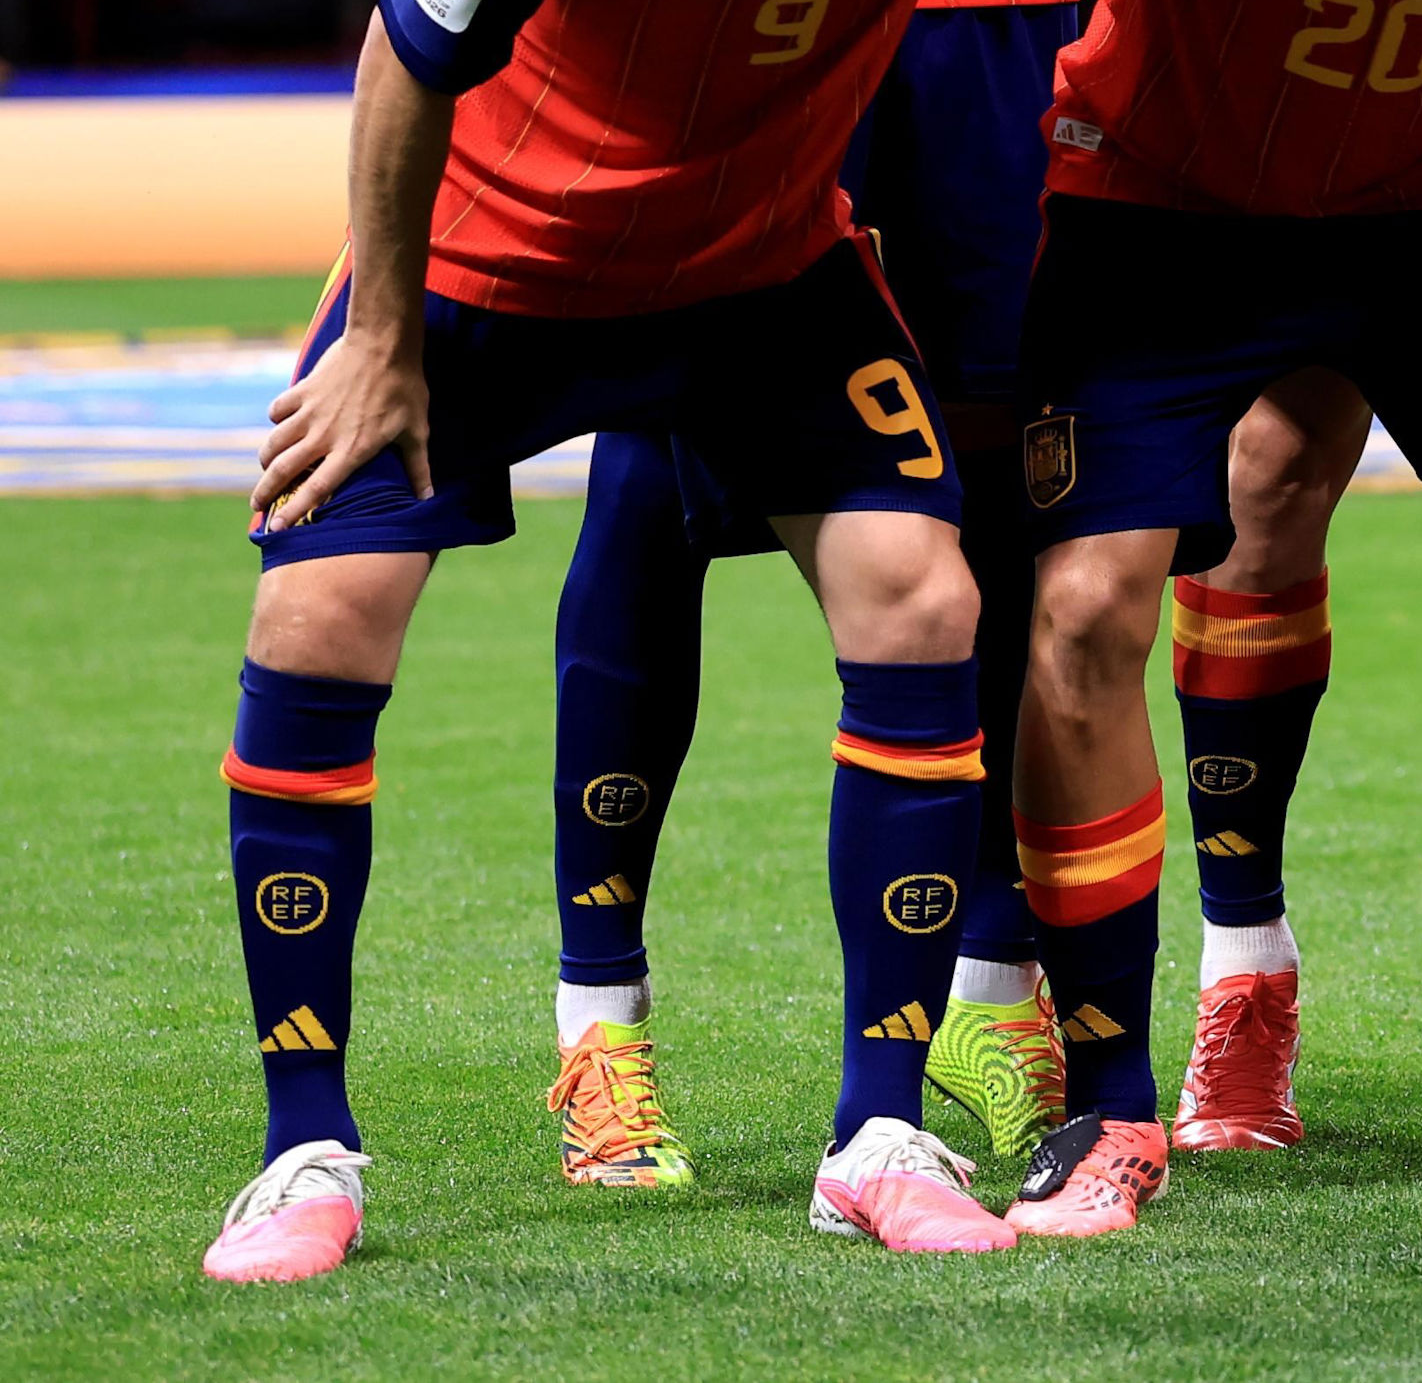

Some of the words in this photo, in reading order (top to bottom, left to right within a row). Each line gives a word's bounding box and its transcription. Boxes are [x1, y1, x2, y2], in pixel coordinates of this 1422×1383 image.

[846, 358, 944, 480] 9
[1203, 762, 1240, 775] RF
[1202, 775, 1239, 786] EF
[600, 785, 638, 800] RF
[598, 802, 634, 816] EF
[271, 885, 314, 902] RF
[902, 886, 944, 902] RF
[271, 904, 313, 921] EF
[901, 904, 943, 920] EF
